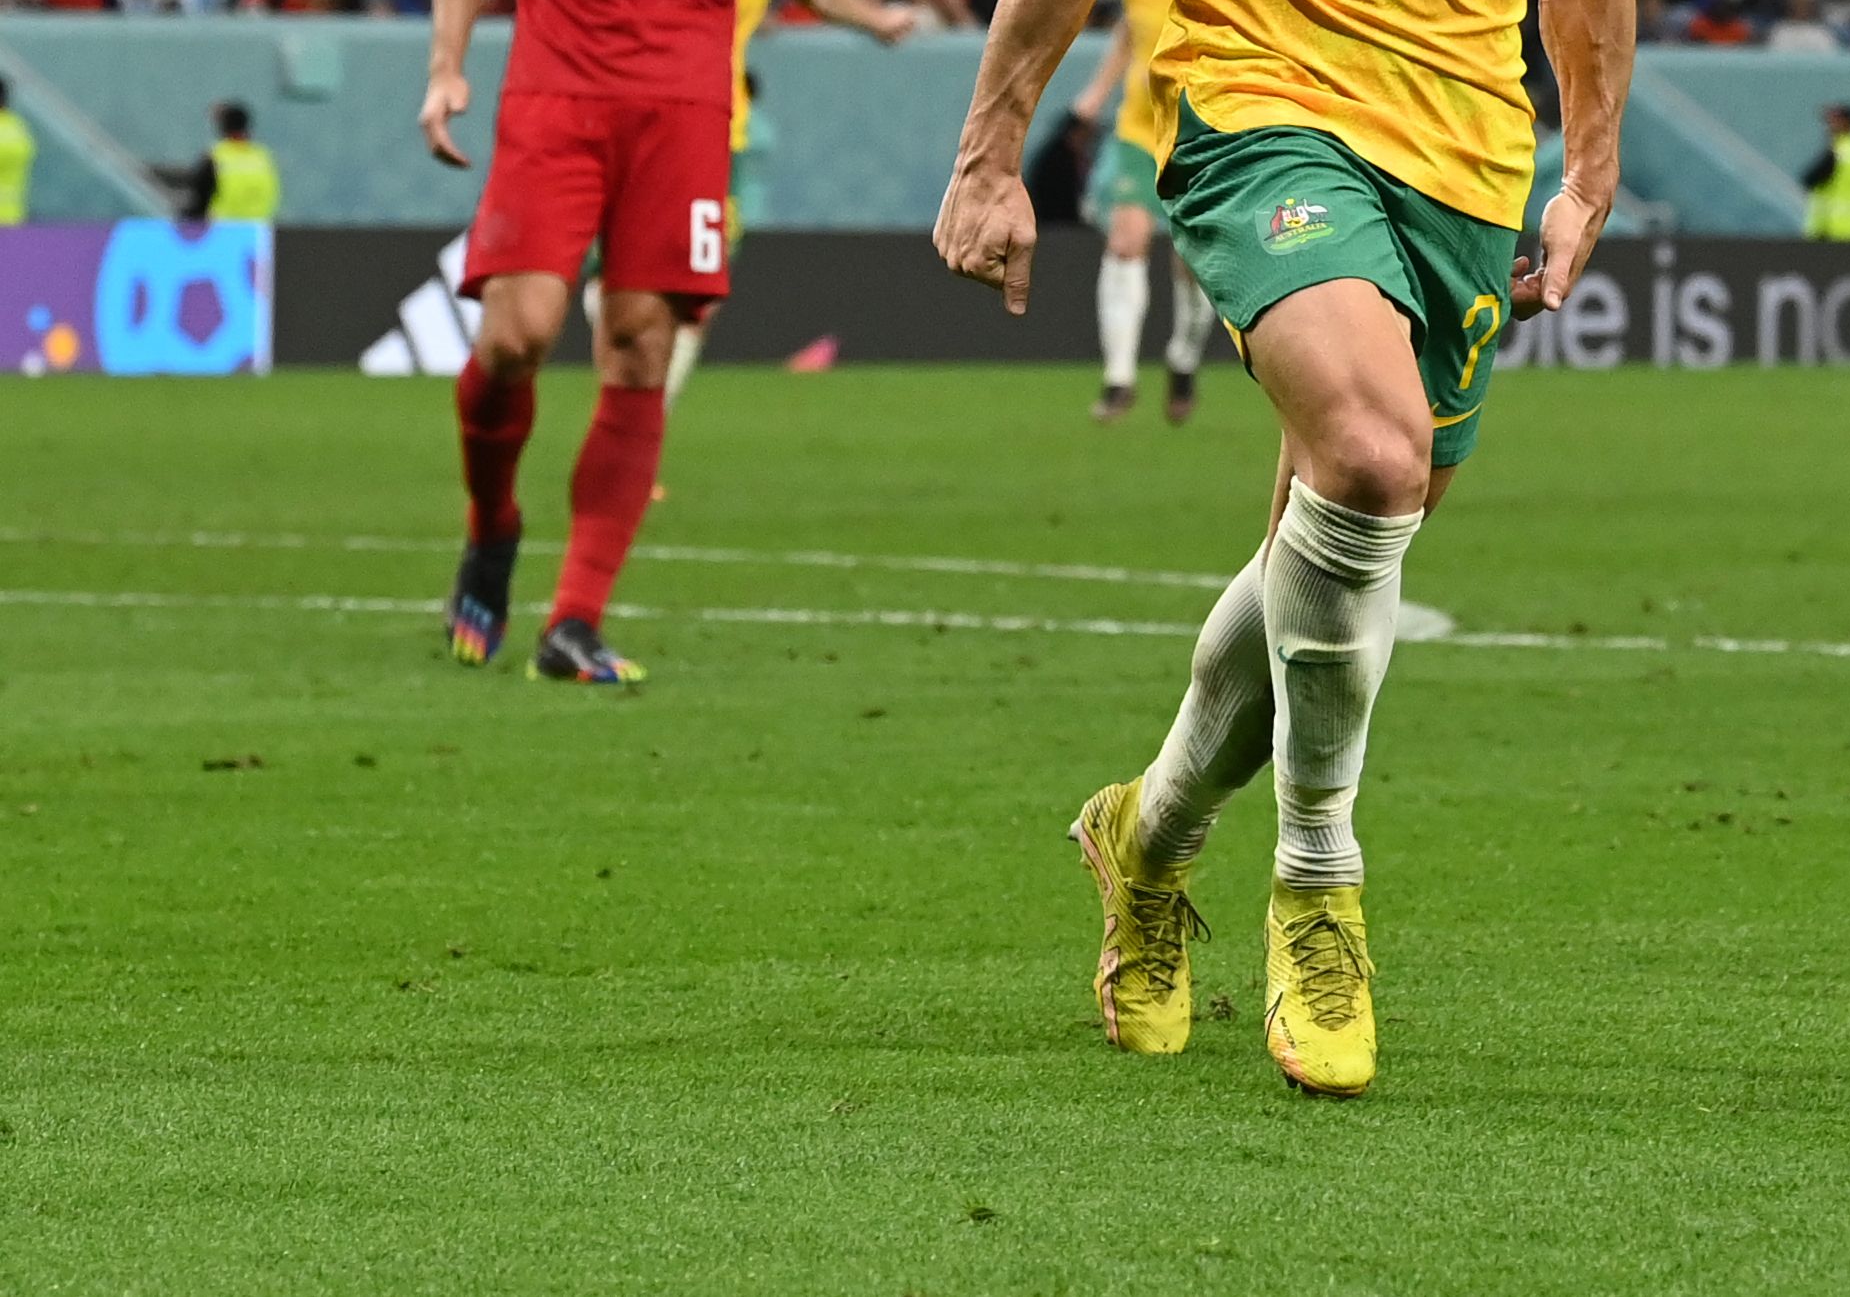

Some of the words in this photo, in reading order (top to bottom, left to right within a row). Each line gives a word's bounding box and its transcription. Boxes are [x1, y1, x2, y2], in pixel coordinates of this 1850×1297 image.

[689, 199, 722, 273] 6
[1459, 294, 1500, 390] 7
[1652, 242, 1735, 371] is
